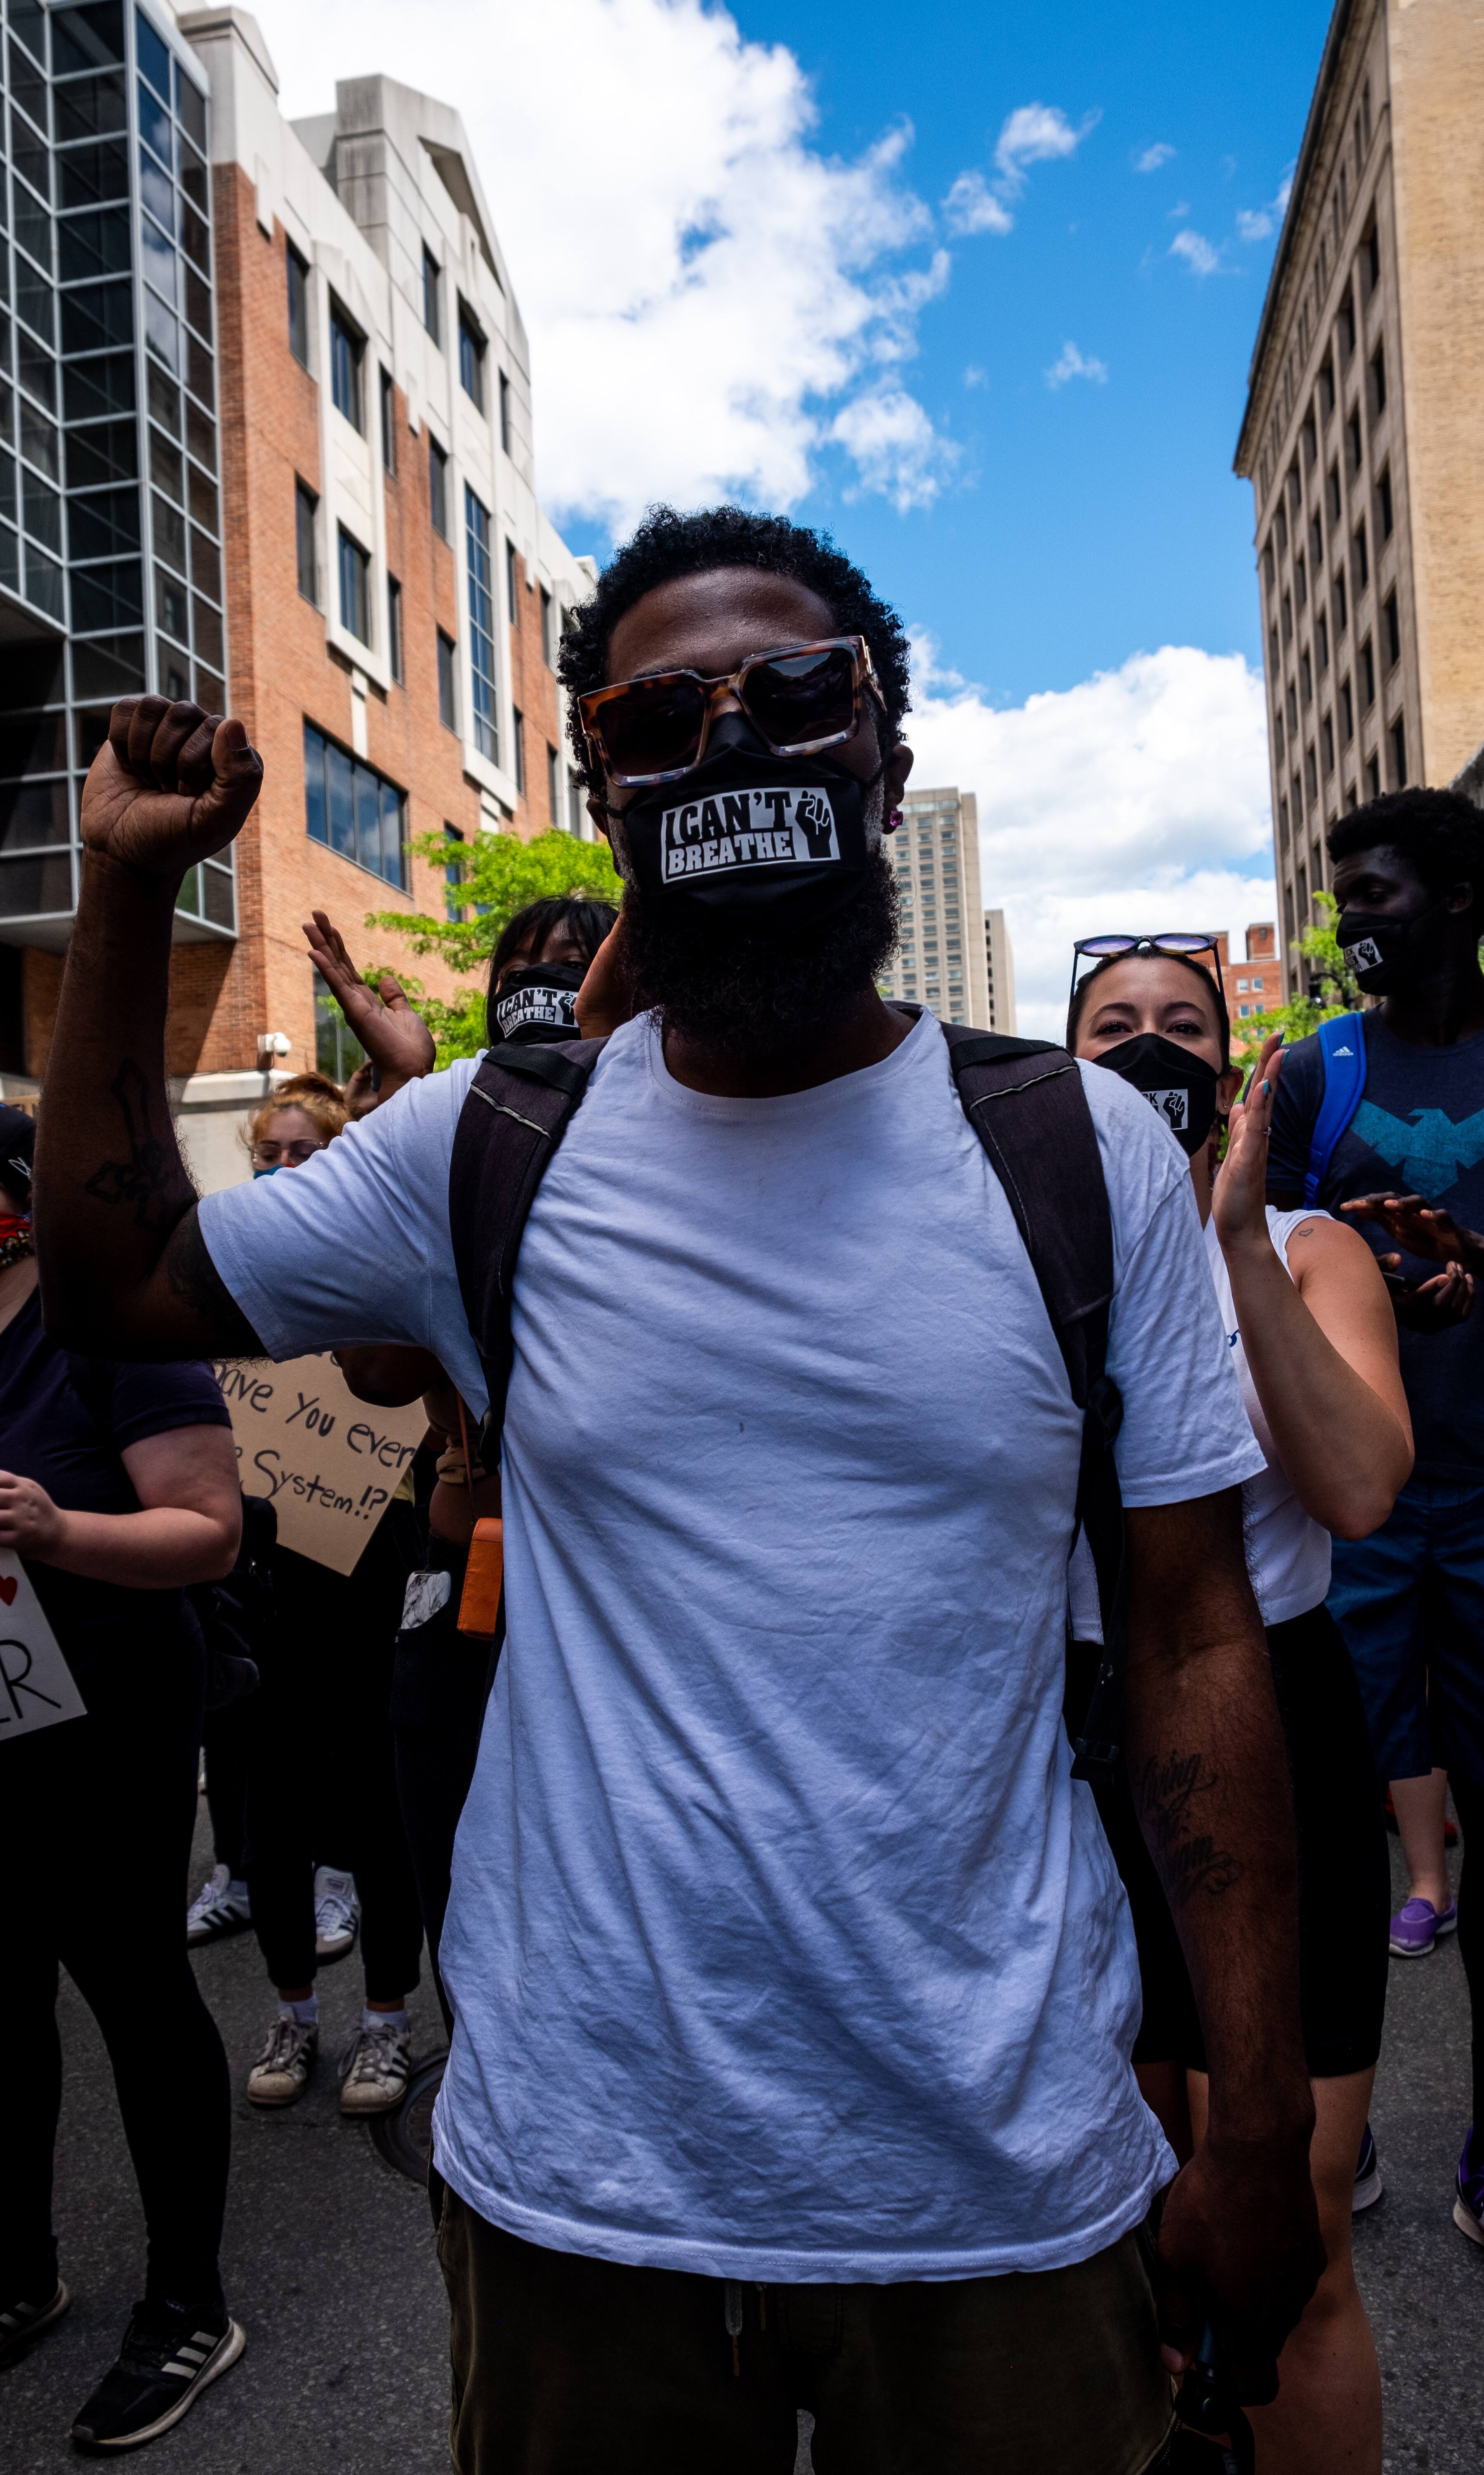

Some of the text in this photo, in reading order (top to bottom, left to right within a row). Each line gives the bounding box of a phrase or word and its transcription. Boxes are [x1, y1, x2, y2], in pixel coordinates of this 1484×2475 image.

[665, 791, 792, 846] I CAN'T
[667, 830, 794, 875] BREATHE
[502, 1006, 554, 1033] BREATHE
[504, 989, 558, 1015] CAN'T
[346, 1423, 416, 1469] ever
